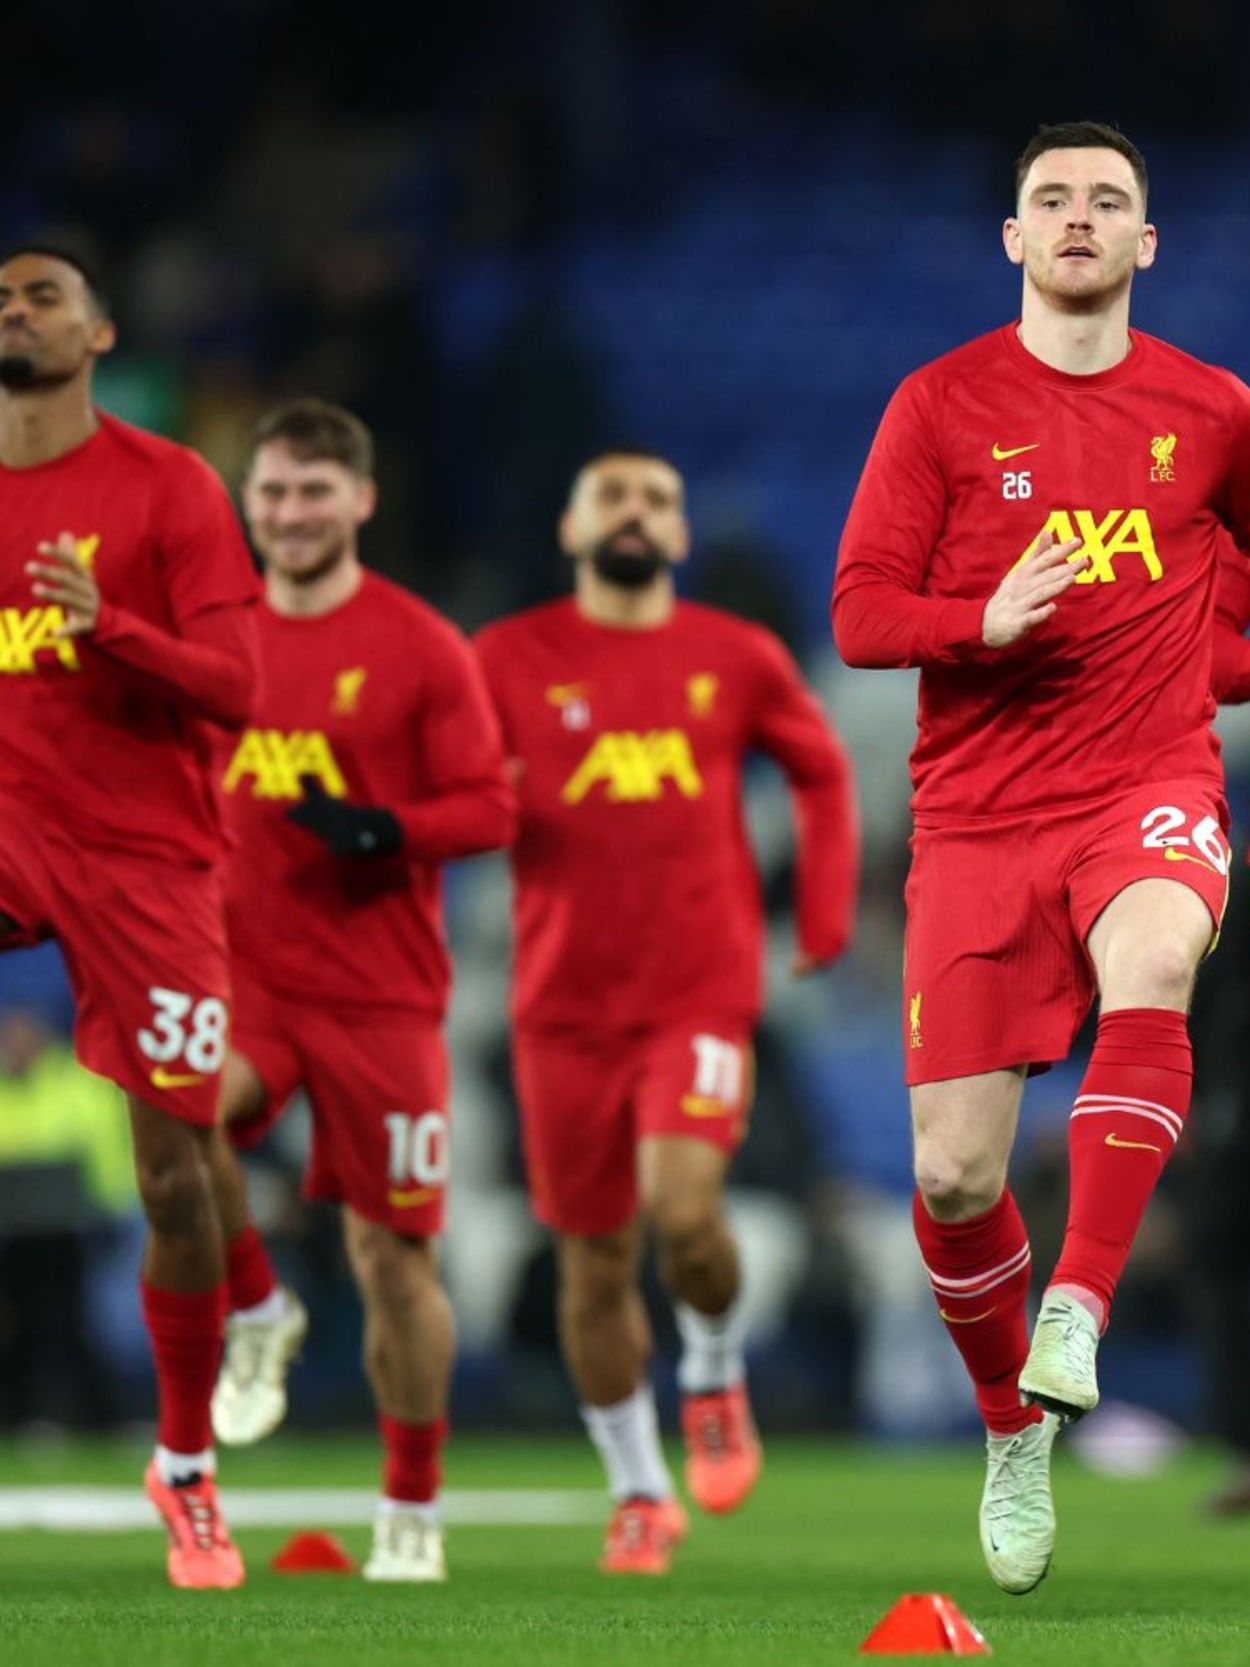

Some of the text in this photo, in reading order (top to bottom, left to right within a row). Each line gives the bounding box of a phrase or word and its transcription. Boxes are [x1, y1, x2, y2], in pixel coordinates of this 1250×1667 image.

[1002, 471, 1032, 500] 26
[1149, 470, 1175, 482] LFC
[0, 606, 79, 674] XA
[222, 728, 347, 799] AXA
[561, 728, 702, 806] AXA
[1141, 805, 1226, 876] 26
[138, 988, 227, 1073] 38
[385, 1111, 446, 1185] 10
